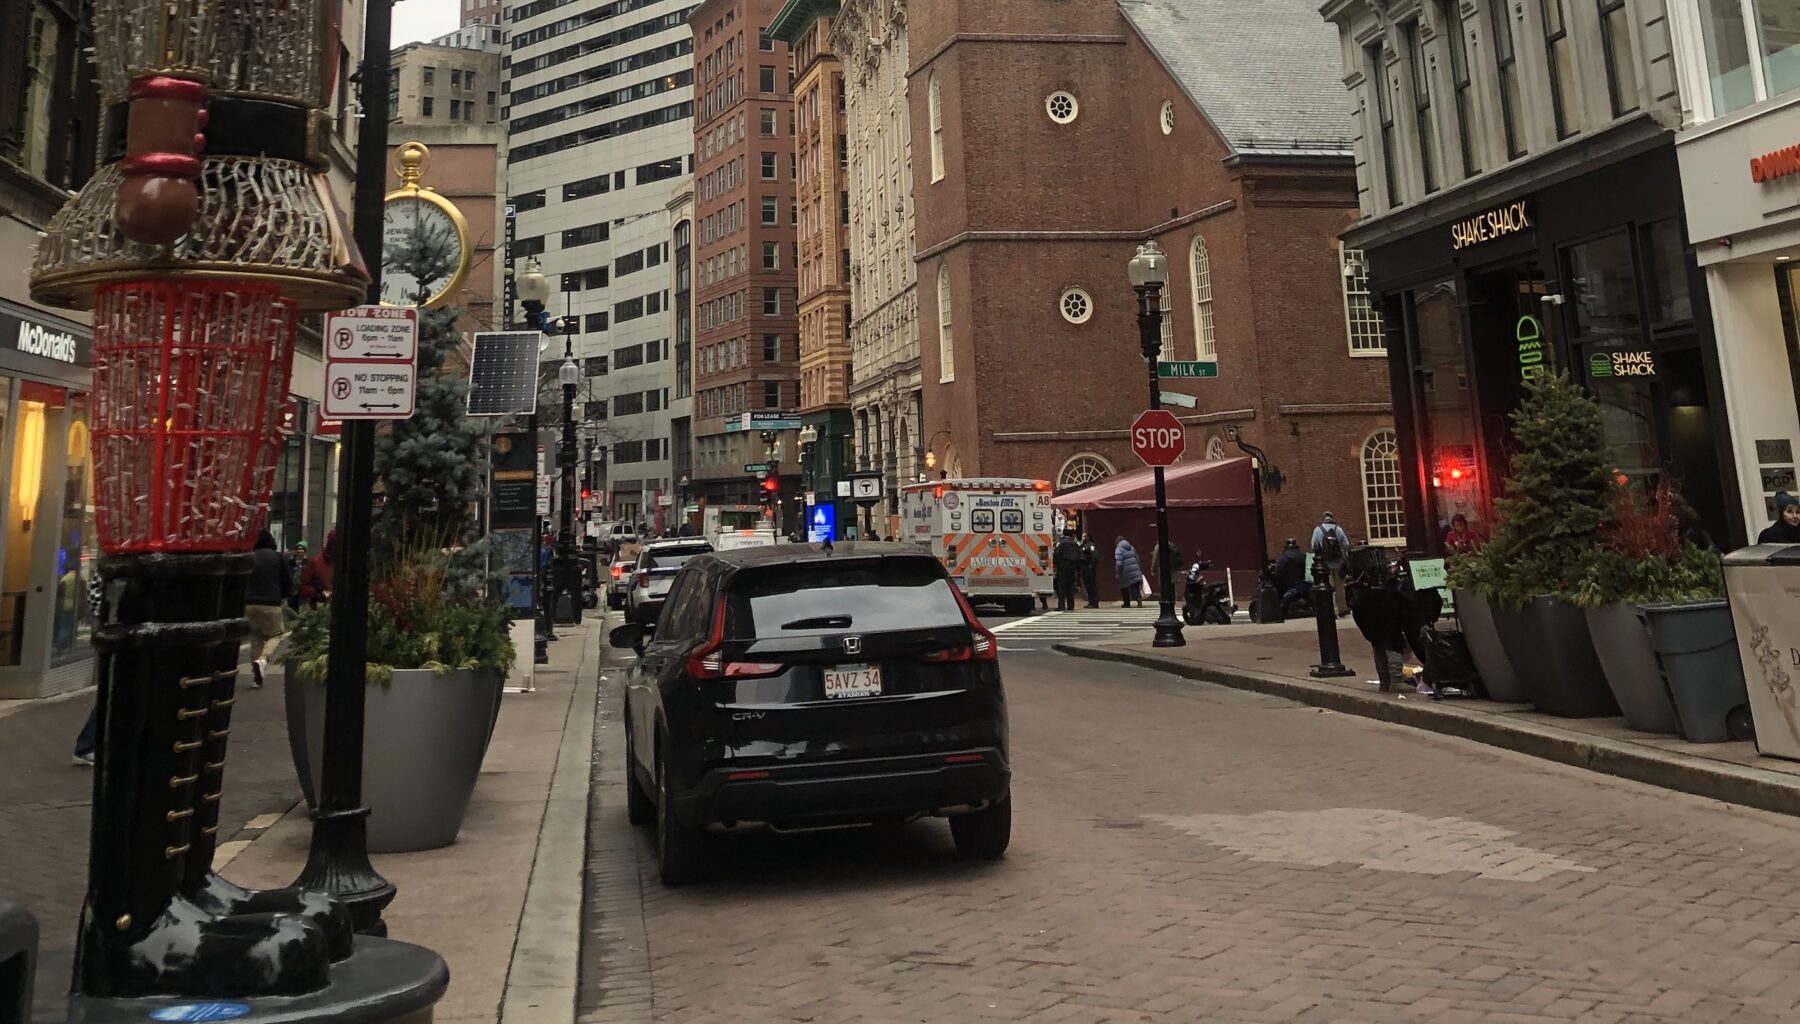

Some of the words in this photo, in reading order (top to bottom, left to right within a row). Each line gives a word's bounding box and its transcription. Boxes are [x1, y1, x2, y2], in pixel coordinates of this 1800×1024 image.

[1452, 215, 1488, 250] SHAKE
[1487, 200, 1529, 239] SHACK
[371, 308, 407, 319] ZONE
[356, 324, 389, 333] LOADING
[391, 325, 411, 333] ZONE
[17, 320, 76, 364] McDonald's
[361, 334, 378, 342] 6pm
[1612, 351, 1653, 364] SHAKE
[1170, 363, 1195, 376] MILK
[1614, 363, 1656, 377] SHACK
[354, 373, 367, 382] NO
[370, 373, 409, 383] STOPPING
[387, 386, 405, 395] 6pm
[1135, 428, 1182, 449] STOP
[1037, 495, 1050, 506] A8
[972, 557, 1025, 567] AMBULANCE
[825, 672, 859, 690] 5AVZ
[863, 671, 880, 687] 34
[732, 711, 766, 721] CR-V
